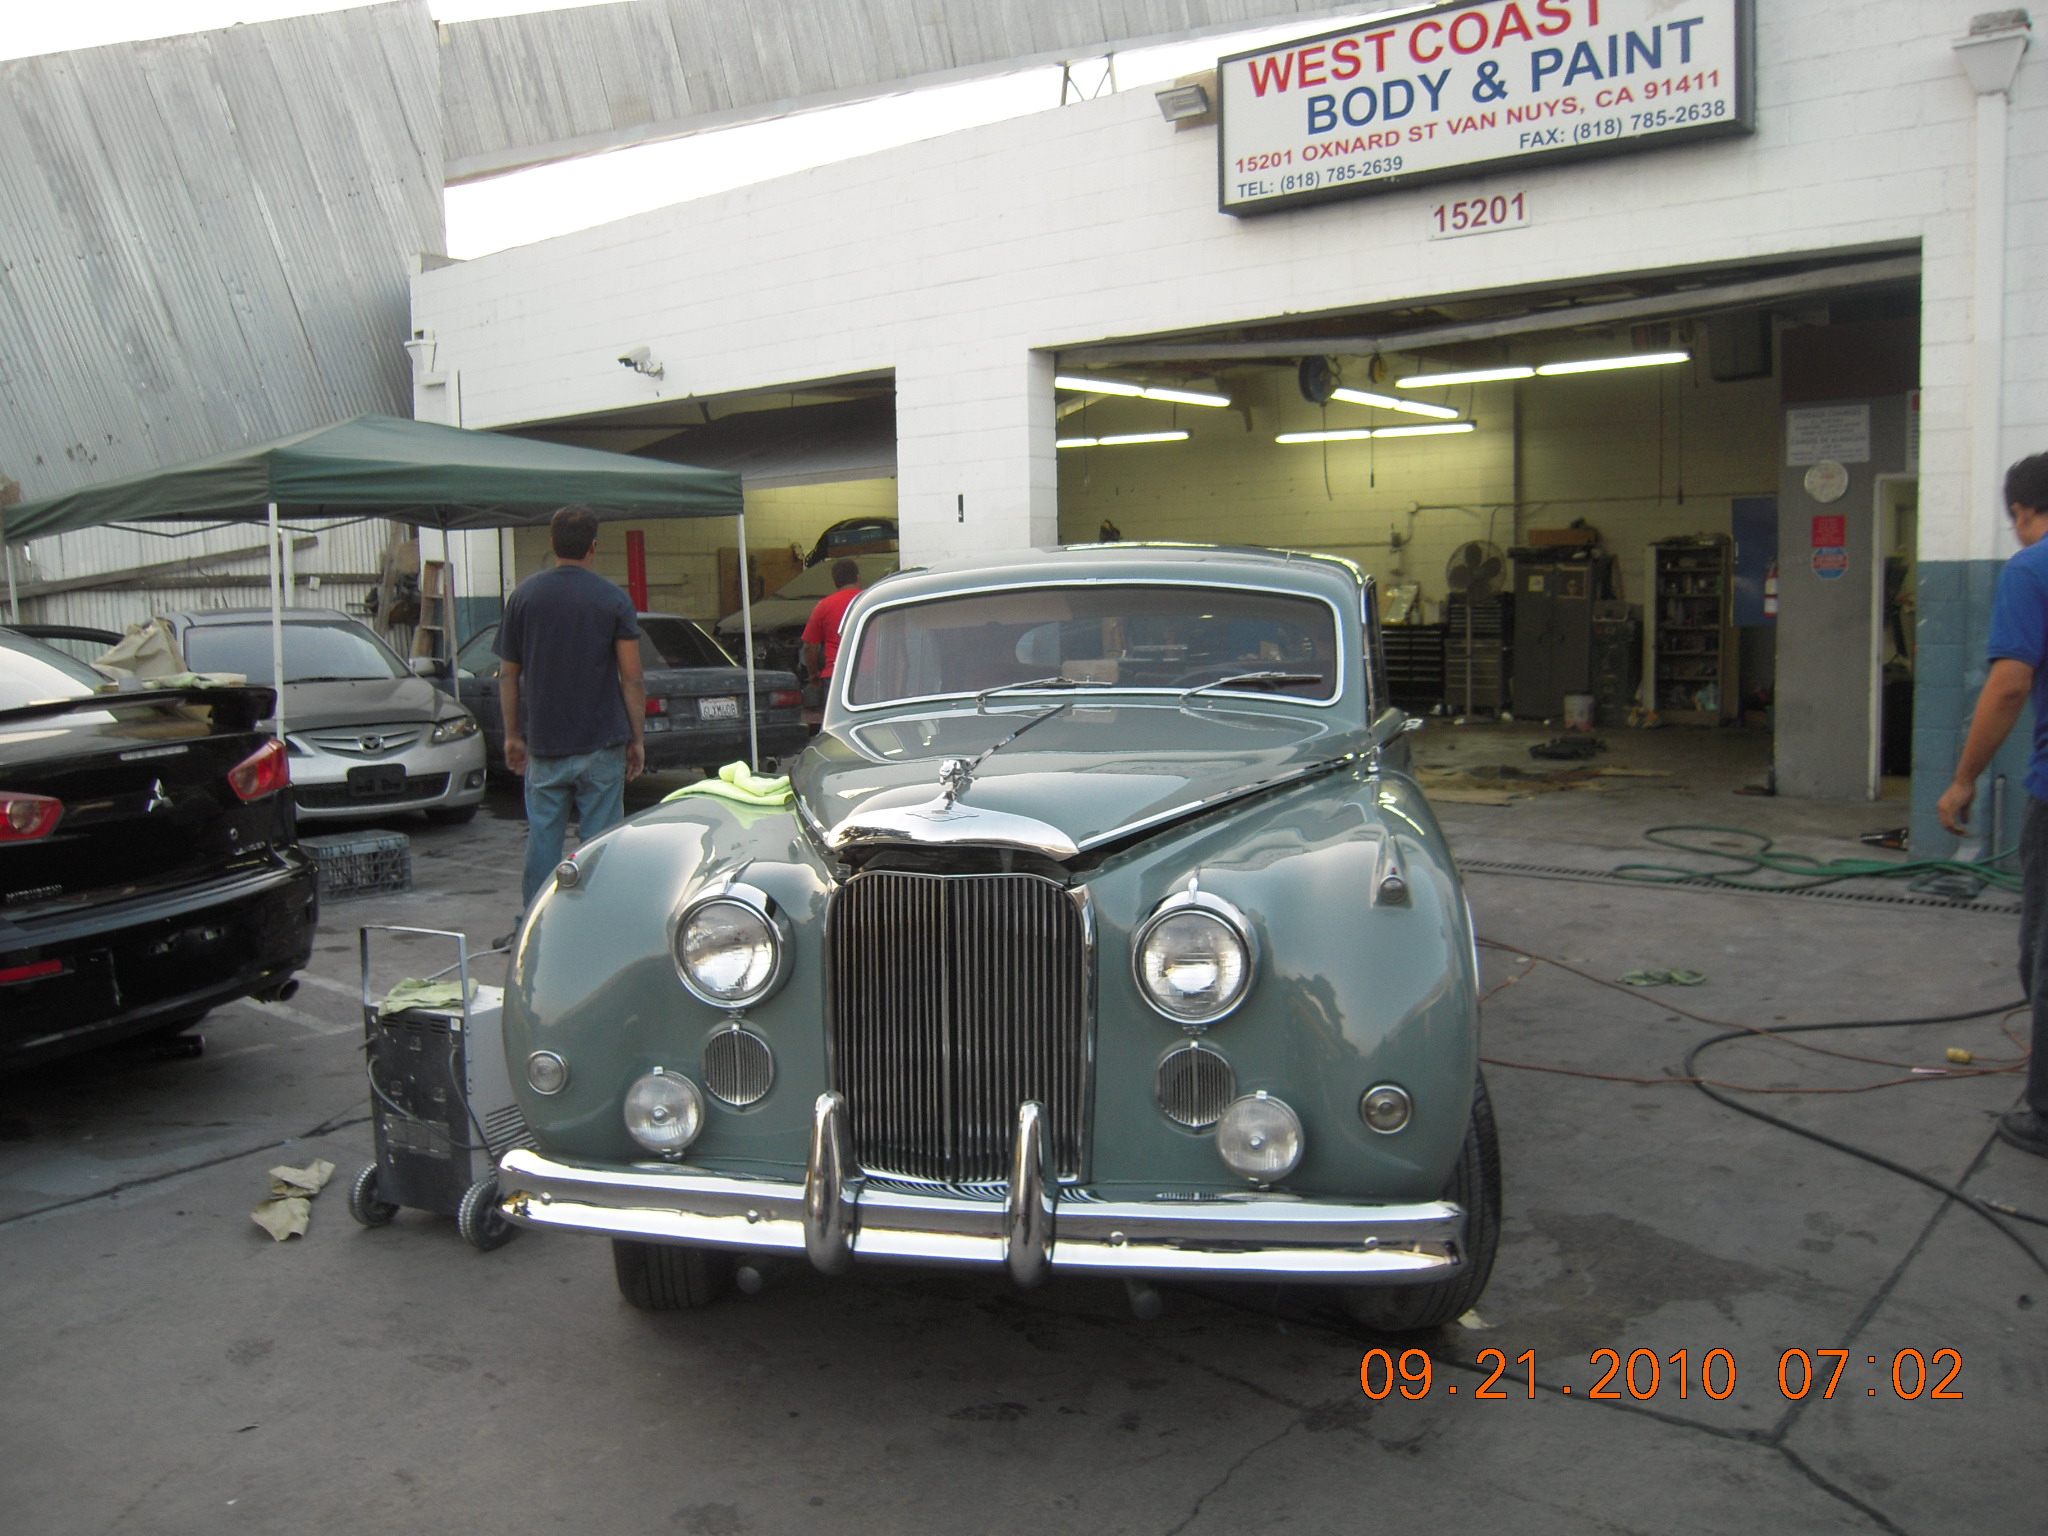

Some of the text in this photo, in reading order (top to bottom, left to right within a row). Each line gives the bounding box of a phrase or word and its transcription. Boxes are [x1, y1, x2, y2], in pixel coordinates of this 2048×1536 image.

[1248, 30, 1395, 97] WEST
[1307, 16, 1704, 135] BODY & PAINT
[1236, 69, 1719, 174] 15201 OXNARD ST VAN NUYS, CA 91411
[1520, 100, 1725, 149] FAX: (818) 785-2638
[1238, 156, 1403, 198] TEL: (818) 785-2639
[1433, 192, 1524, 232] 15201
